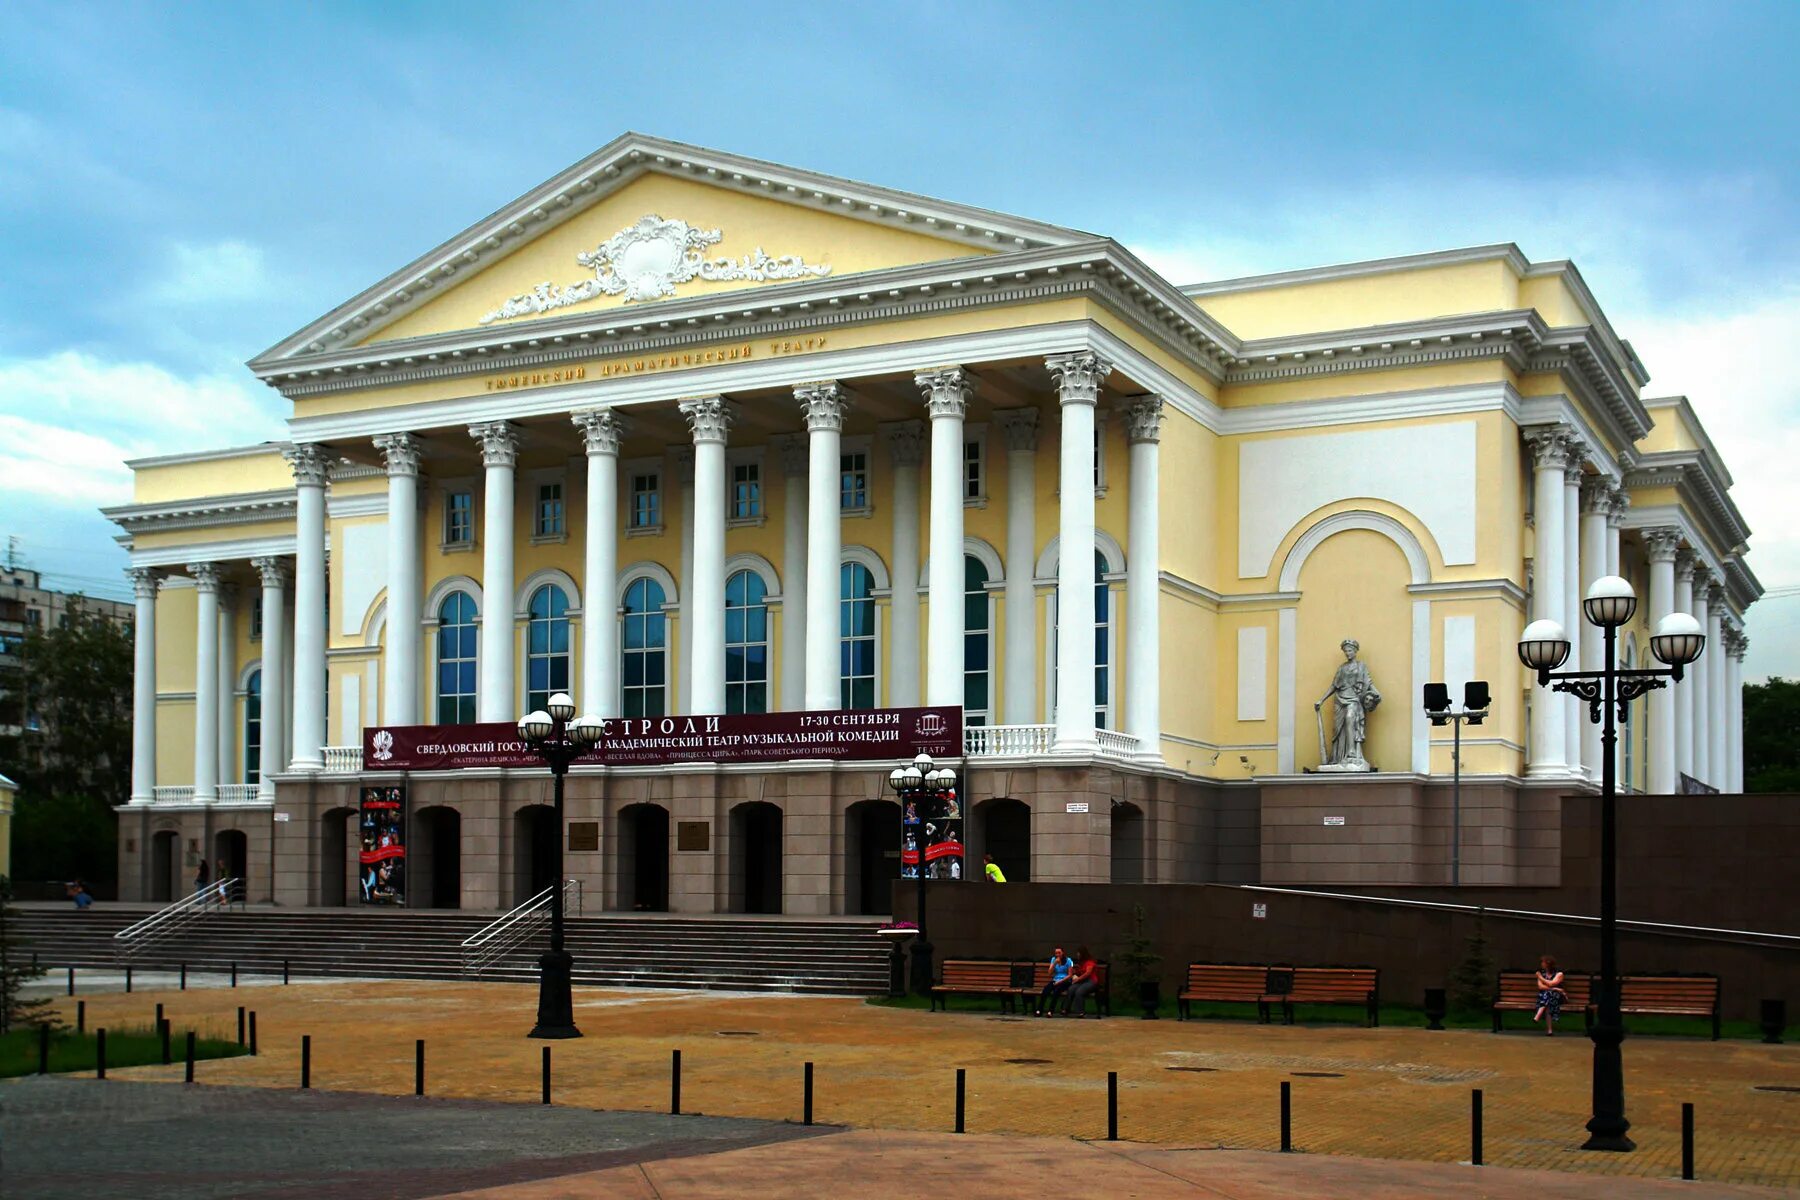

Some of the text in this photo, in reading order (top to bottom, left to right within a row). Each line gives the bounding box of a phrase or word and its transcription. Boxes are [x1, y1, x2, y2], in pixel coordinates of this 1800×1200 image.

[485, 336, 827, 390] ТЮМЕНСКИЙ ДРАМАТИЧЕСКИЙ ТЕАТР
[800, 713, 900, 727] 17-30 СЕНТЯБРЯ
[416, 741, 494, 755] СВЕРДЛОВСКИЙ
[604, 735, 703, 750] АКАДЕМИЧЕСКИЙ
[706, 735, 740, 746] ТЕАТР
[743, 730, 834, 744] МУЗЫКАЛЬНОЙ
[838, 730, 900, 743] КОМЕДИИ
